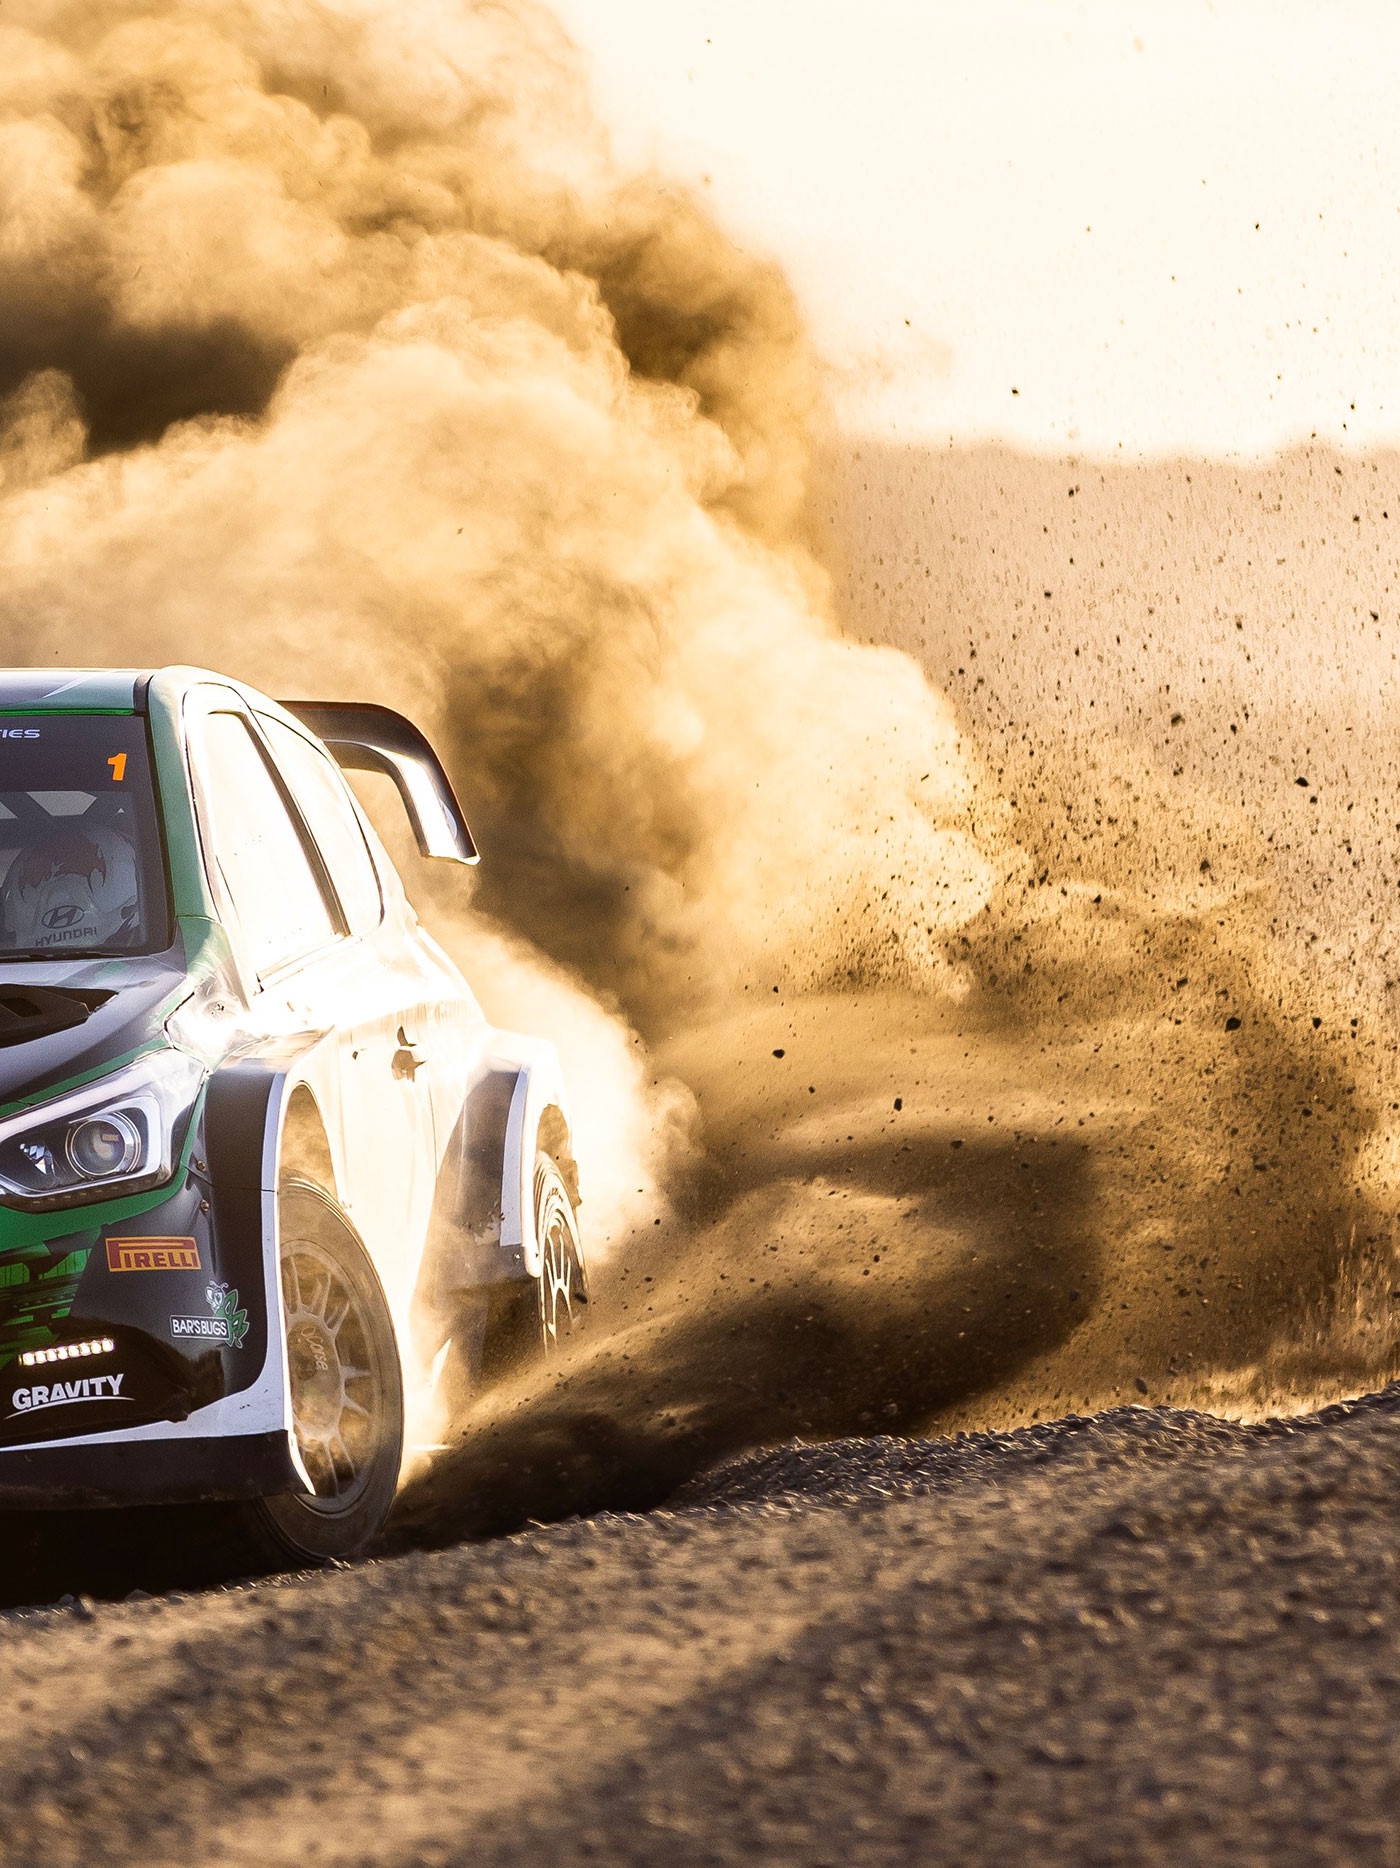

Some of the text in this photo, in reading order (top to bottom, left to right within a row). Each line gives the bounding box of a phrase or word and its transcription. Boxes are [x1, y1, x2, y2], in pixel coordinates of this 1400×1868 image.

[107, 752, 127, 781] 1
[35, 926, 98, 947] HYUNDAI
[108, 1238, 199, 1269] PIRELLI
[201, 1319, 228, 1336] BUGS
[11, 1373, 124, 1410] GRAVITY
